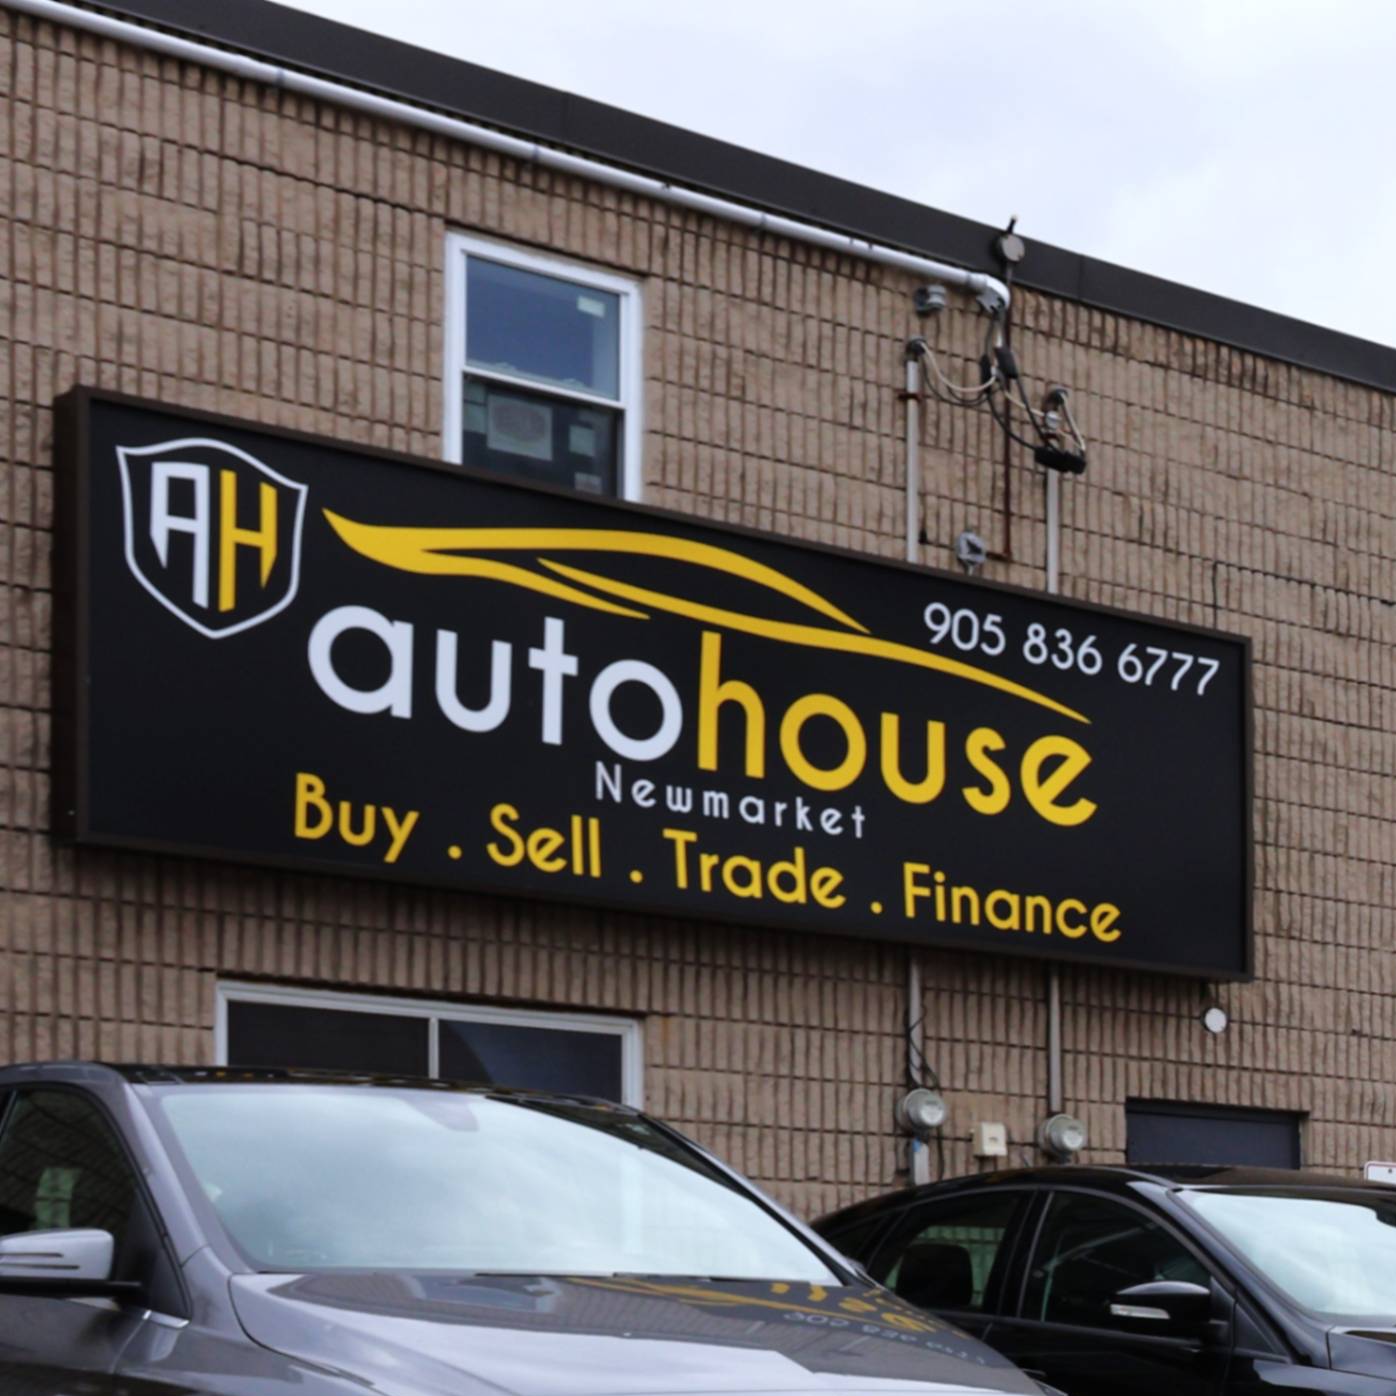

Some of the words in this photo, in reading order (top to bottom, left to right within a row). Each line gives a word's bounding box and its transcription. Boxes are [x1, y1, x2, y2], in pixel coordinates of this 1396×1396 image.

[923, 603, 1005, 656] 905
[1023, 623, 1102, 675] 836
[1117, 644, 1220, 696] 6777
[308, 605, 1097, 827] autohouse
[295, 773, 419, 863] Buy
[487, 804, 602, 878] Sell
[663, 829, 846, 909] Trade
[903, 862, 1122, 942] Finance
[595, 761, 866, 838] Newmarket
